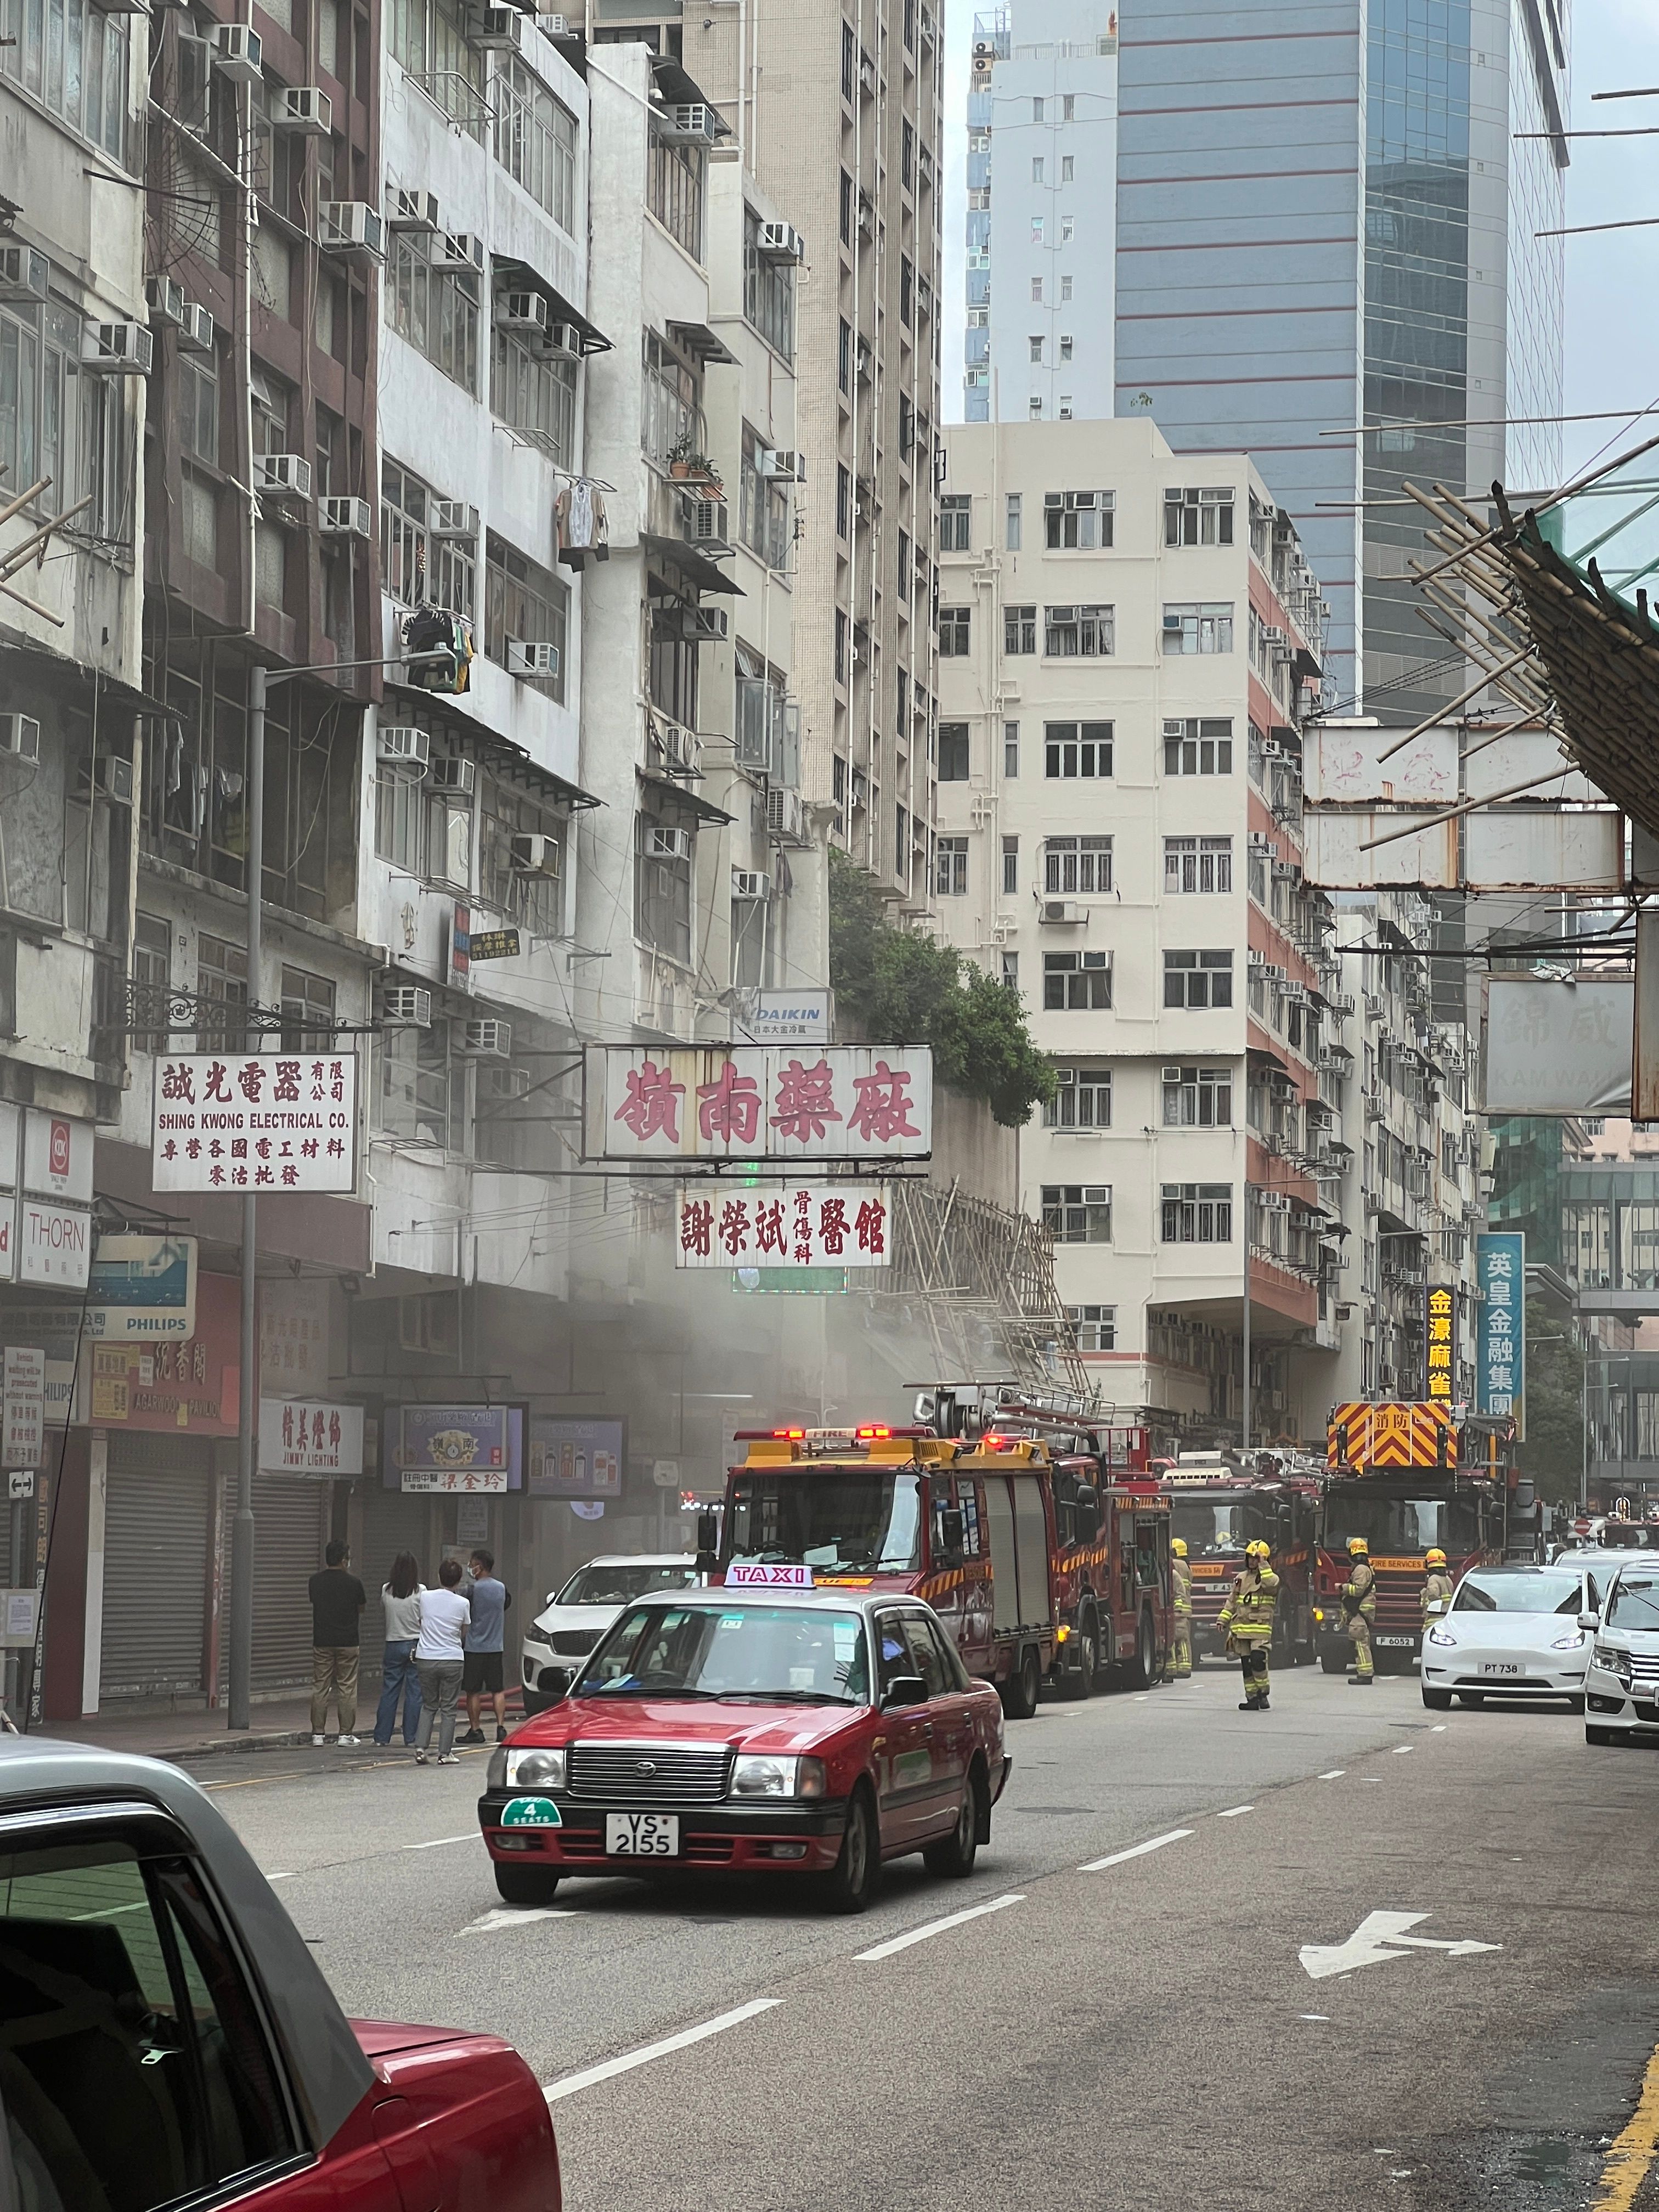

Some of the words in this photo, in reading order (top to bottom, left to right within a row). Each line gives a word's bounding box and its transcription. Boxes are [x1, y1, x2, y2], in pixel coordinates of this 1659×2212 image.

[755, 1009, 820, 1020] DAIKIN
[161, 1060, 302, 1105] 誠光電器
[613, 1058, 922, 1144] 嶺南藥廠
[159, 1113, 195, 1130] SHING
[201, 1113, 244, 1129] KWONG
[250, 1113, 323, 1128] ELECTRICAL
[329, 1113, 349, 1128] CO.
[208, 1164, 300, 1186] 零沽批發
[29, 1212, 84, 1252] THORN
[680, 1199, 787, 1256] 謝榮斌
[793, 1190, 813, 1265] 骨傷科
[818, 1198, 887, 1255] 醫館
[3, 1313, 105, 1326] 電器有限公司
[127, 1318, 187, 1331] PHILIPS
[1428, 1289, 1452, 1396] 金濠麻雀
[1487, 1252, 1513, 1415] 英皇金融集團
[282, 1405, 342, 1453] 精美燈飾
[1376, 1413, 1408, 1429] 消防
[283, 1451, 304, 1465] JIMMY
[307, 1453, 339, 1468] LIGHTING
[733, 1566, 804, 1583] TAXI
[1484, 1663, 1498, 1674] PT
[1499, 1663, 1518, 1674] 738
[523, 1803, 537, 1816] 4
[513, 1815, 550, 1825] SEATS
[628, 1814, 657, 1835] VS
[615, 1833, 670, 1854] 2155
